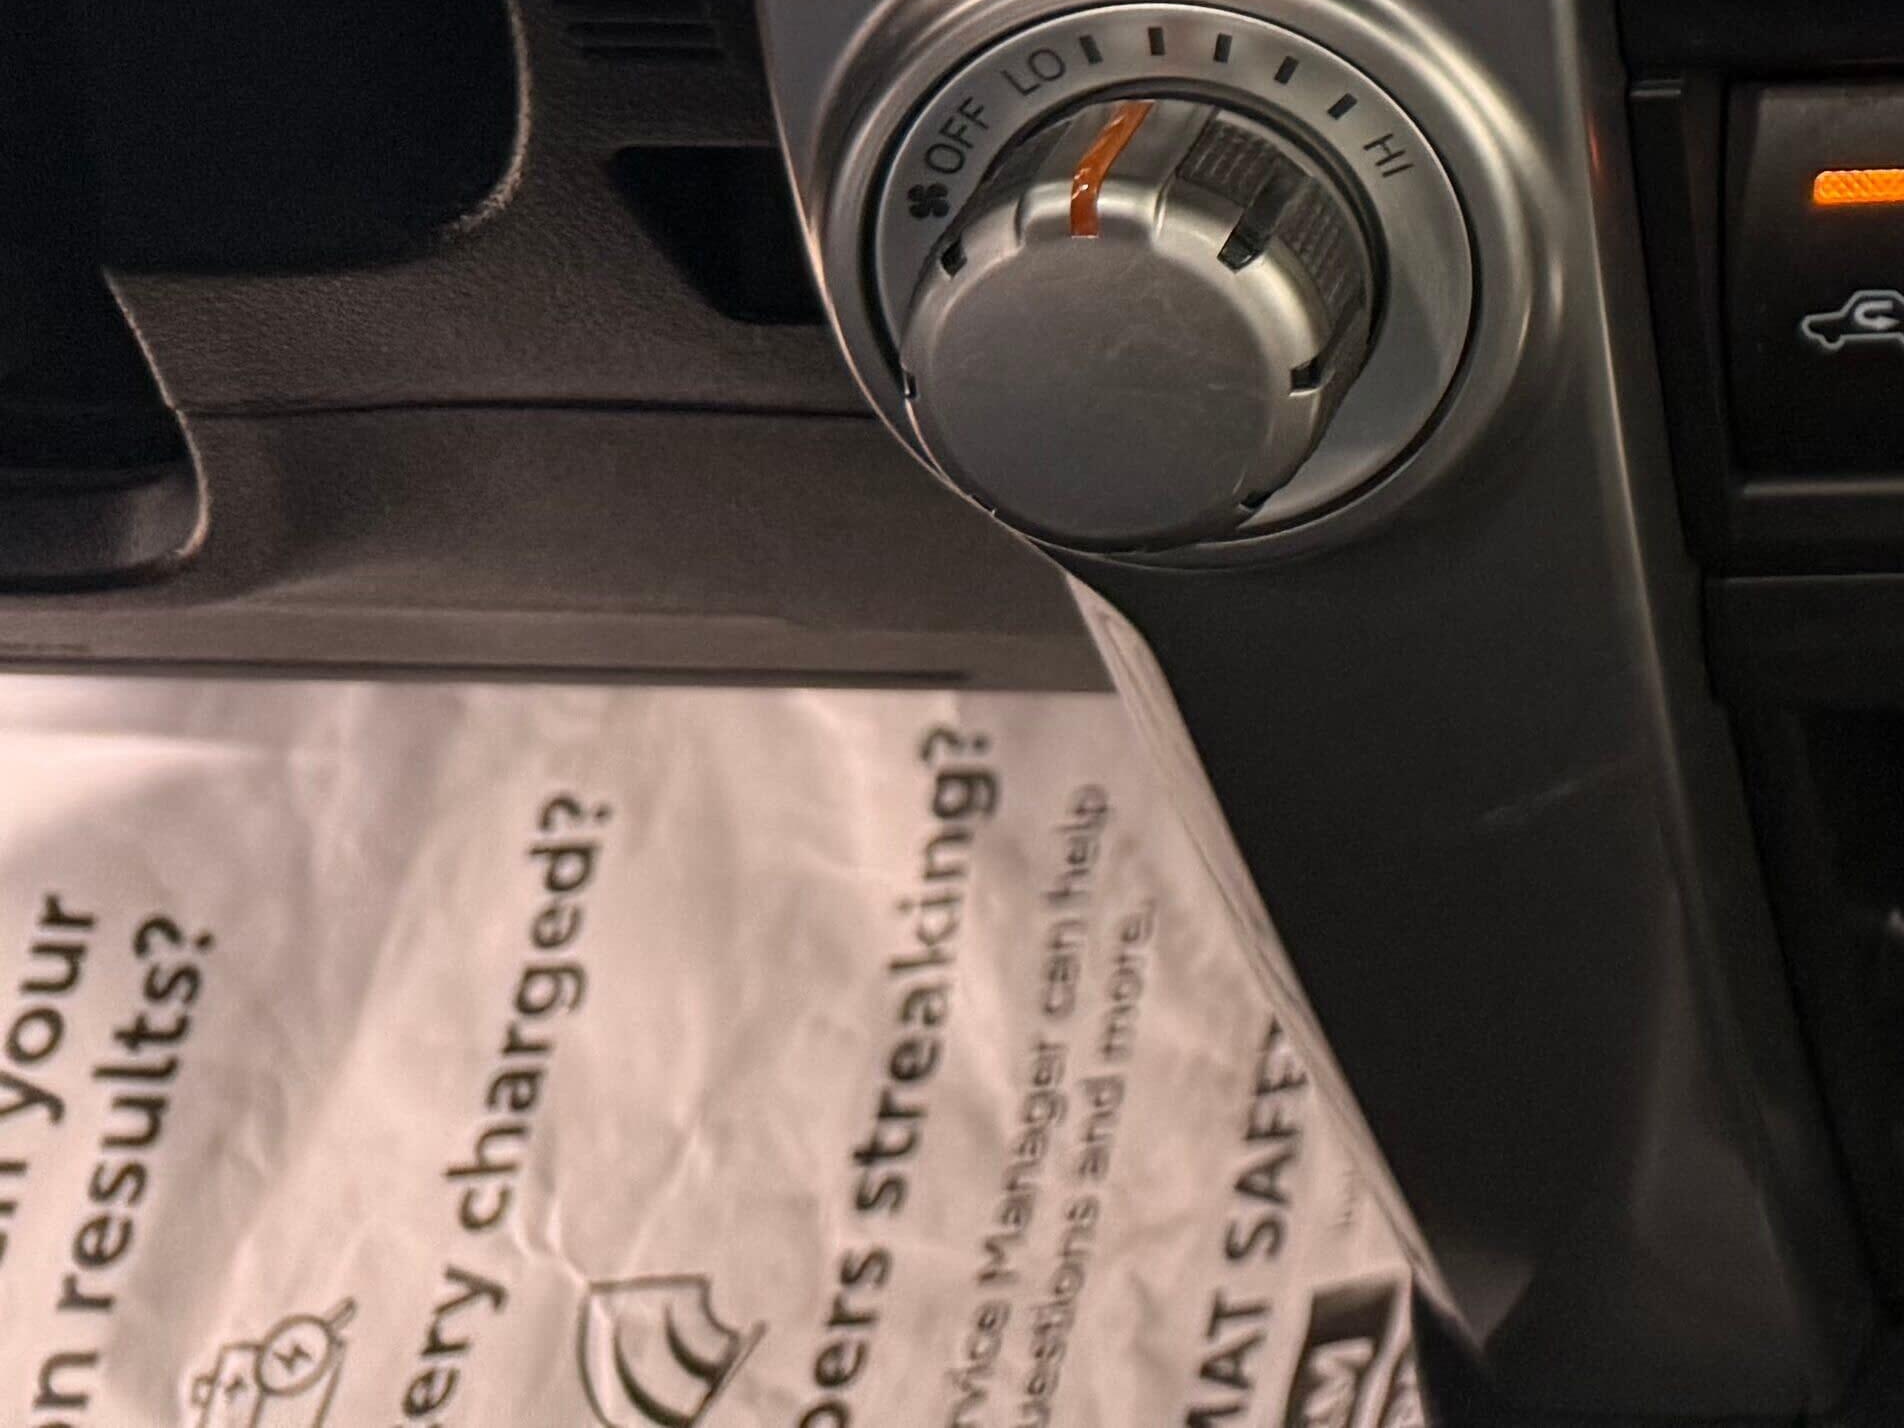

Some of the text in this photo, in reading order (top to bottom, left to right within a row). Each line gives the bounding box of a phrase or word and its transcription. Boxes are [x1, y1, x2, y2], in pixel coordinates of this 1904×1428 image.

[1001, 47, 1067, 97] LO
[929, 95, 991, 176] OFF
[1363, 132, 1416, 179] HI
[1041, 782, 1111, 909] help
[444, 794, 613, 1233] charged?
[852, 720, 998, 1226] streaking?
[1041, 912, 1084, 1019] can
[56, 914, 214, 1314] results?
[976, 1030, 1069, 1286] Manager
[1074, 1068, 1130, 1184] and
